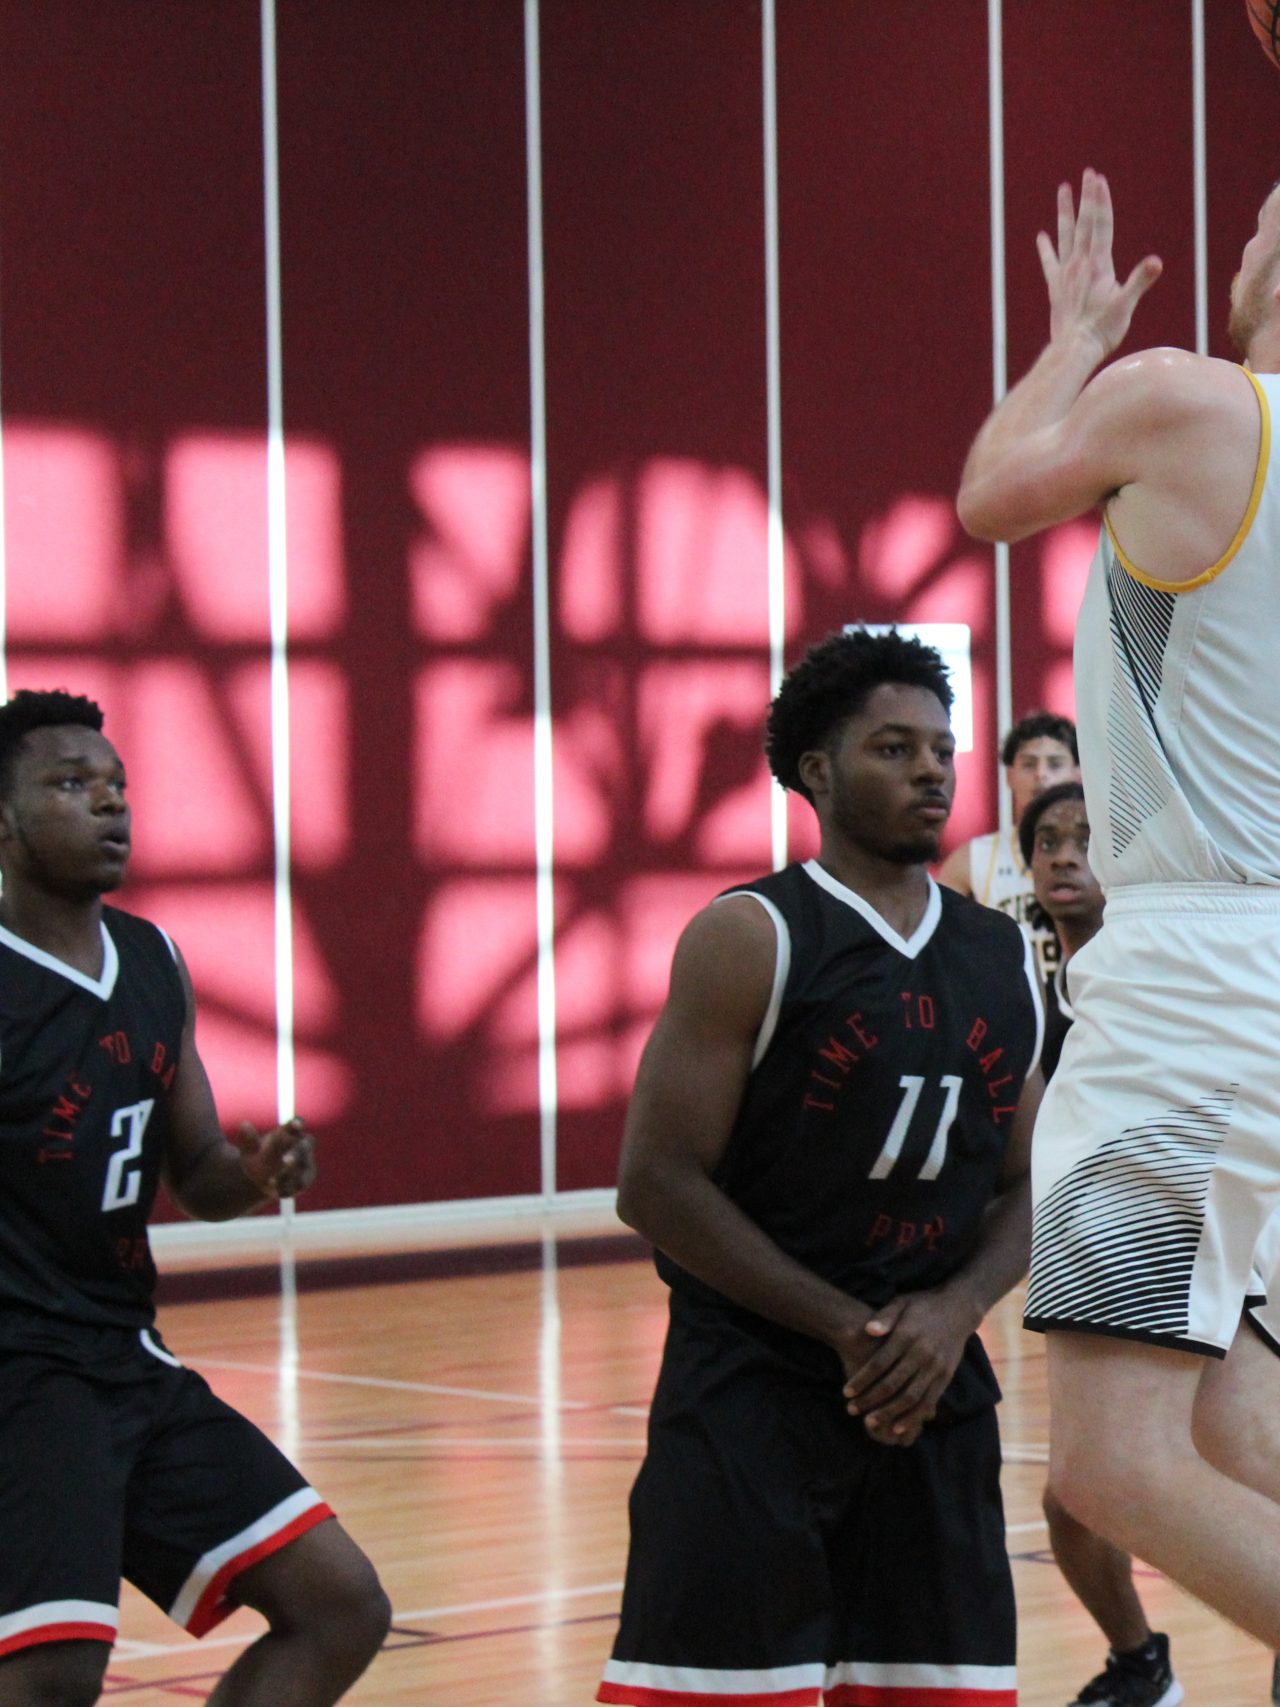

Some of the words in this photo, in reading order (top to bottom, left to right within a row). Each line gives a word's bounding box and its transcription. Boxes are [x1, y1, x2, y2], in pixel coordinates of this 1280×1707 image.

[36, 1074, 93, 1164] TIME
[151, 1041, 177, 1090] BA
[803, 1011, 880, 1112] TIME
[901, 992, 935, 1030] TO
[965, 1016, 1020, 1124] BALL
[101, 1098, 154, 1212] 2
[867, 1073, 964, 1181] 11
